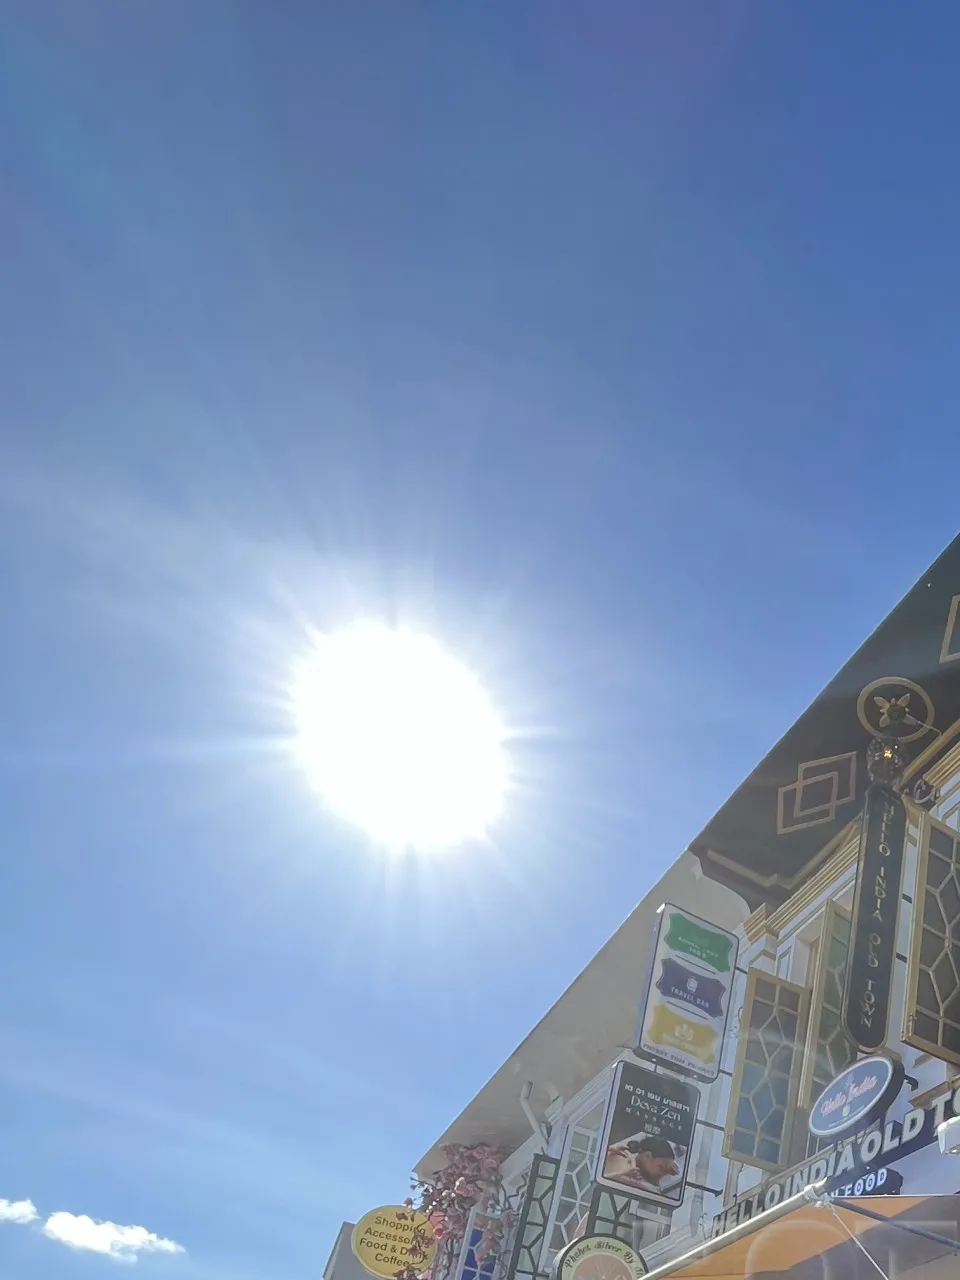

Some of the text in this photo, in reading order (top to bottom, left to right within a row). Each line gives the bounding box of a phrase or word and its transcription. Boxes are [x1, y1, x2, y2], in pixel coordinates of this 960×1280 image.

[872, 866, 886, 923] INDIA
[868, 932, 882, 968] OLD
[861, 979, 876, 1029] TOWN
[630, 1095, 681, 1122] Deva Zen
[860, 1109, 926, 1163] OLD
[844, 1168, 888, 1197] FOOD
[360, 1238, 388, 1251] Food
[390, 1245, 397, 1254] &
[374, 1253, 411, 1267] Coffee
